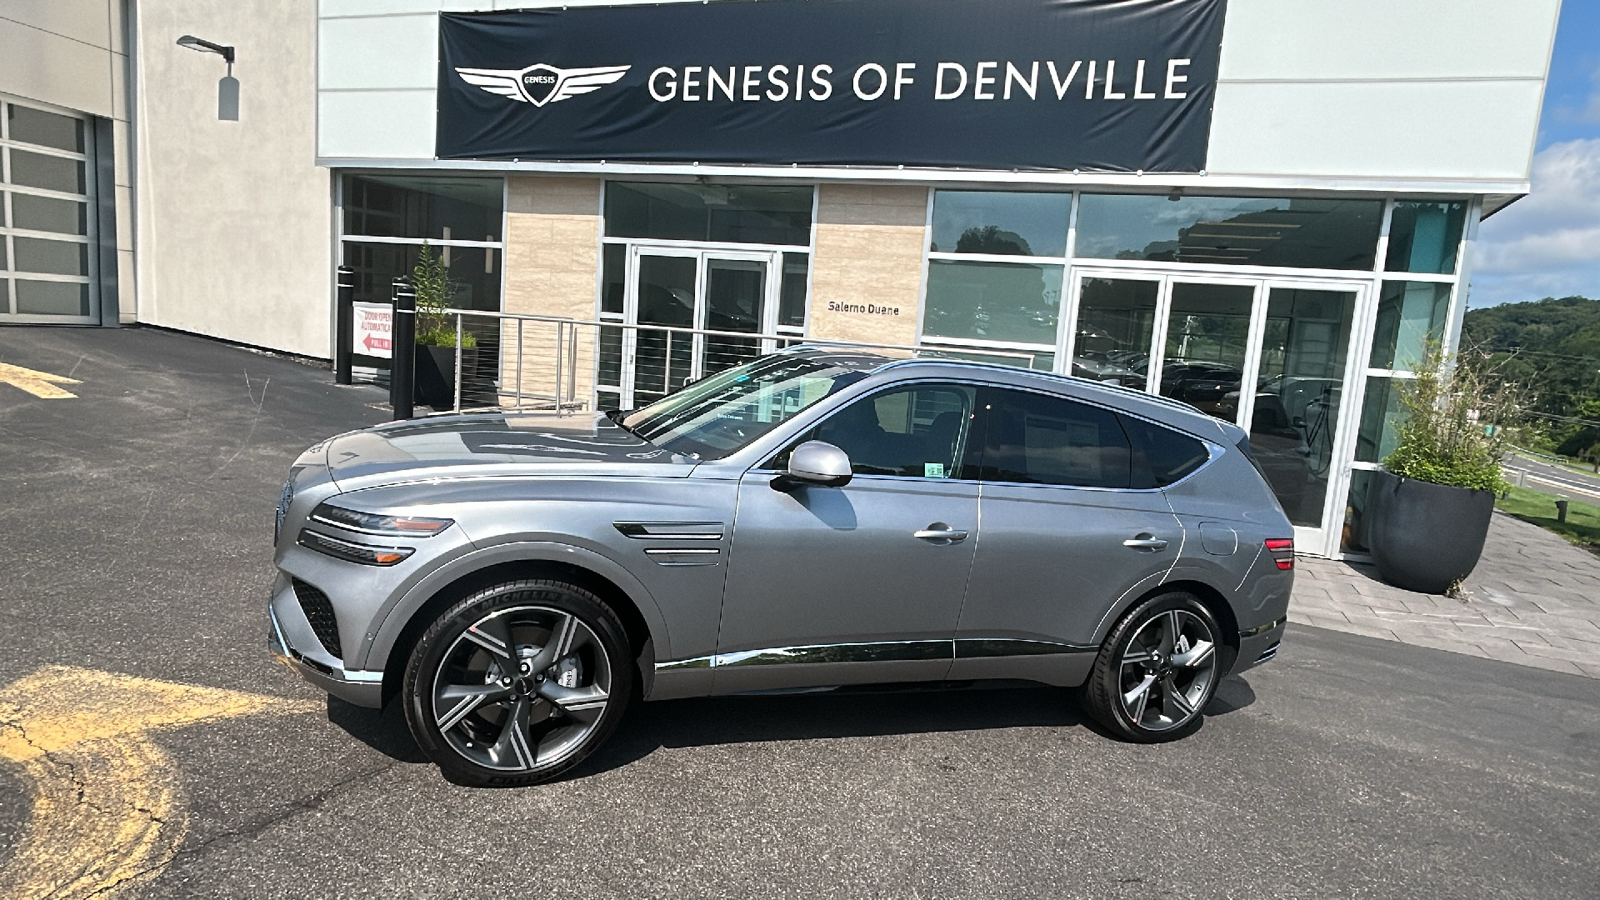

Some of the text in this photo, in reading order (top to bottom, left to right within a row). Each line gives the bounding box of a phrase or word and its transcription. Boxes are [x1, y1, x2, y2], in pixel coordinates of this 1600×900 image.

[524, 75, 556, 85] GENESIS
[648, 58, 1191, 103] GENESIS OF DENVILLE
[827, 301, 899, 316] Salerno Duane
[364, 311, 379, 321] DOOR
[370, 339, 382, 348] PULL
[481, 590, 558, 605] MICHELIN
